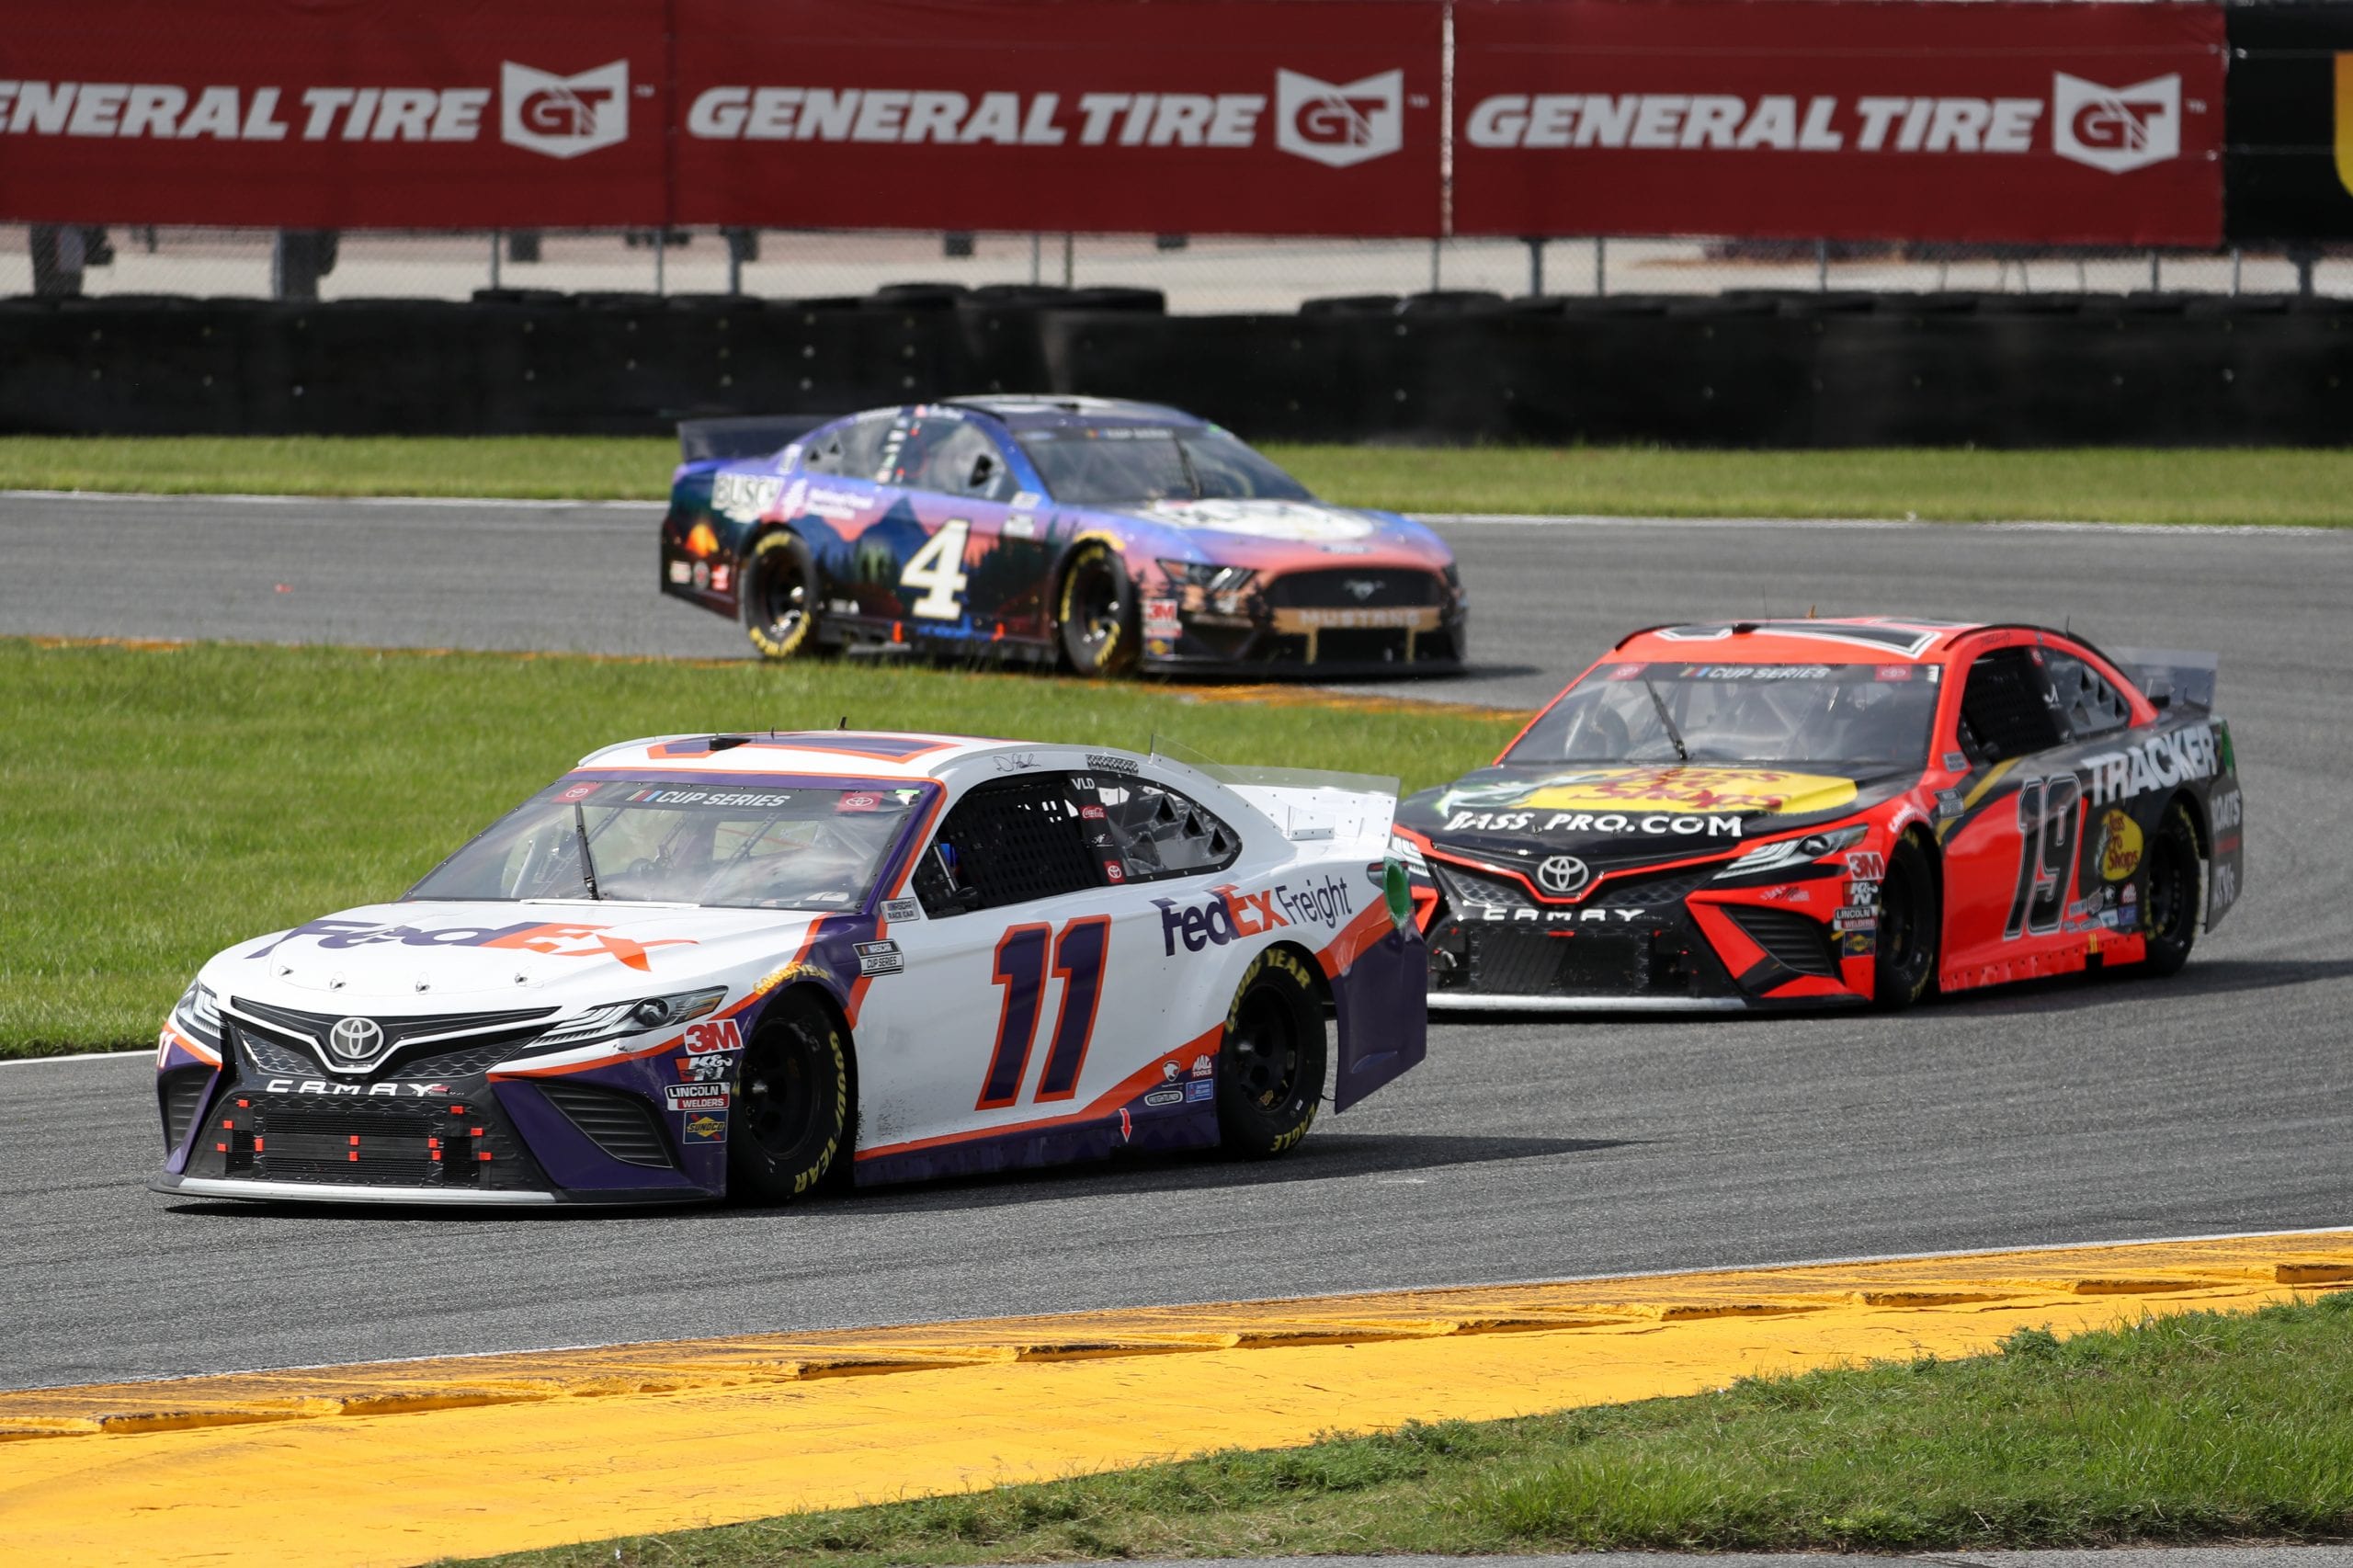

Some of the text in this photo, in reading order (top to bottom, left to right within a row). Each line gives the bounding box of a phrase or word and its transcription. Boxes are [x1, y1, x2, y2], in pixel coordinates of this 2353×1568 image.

[0, 79, 491, 141] NERAL TIRE
[688, 86, 1267, 147] GENERAL TIRE
[1466, 94, 2043, 153] GENERAL TIRE
[900, 517, 972, 620] 4
[1148, 603, 1175, 620] 3M
[1300, 610, 1421, 627] MUSTANG
[1709, 666, 1832, 679] CUP SERIES
[2081, 724, 2218, 807] TRACKER
[1071, 778, 1096, 790] VLD
[654, 790, 790, 807] CUP SERIES
[1443, 811, 1536, 833] BASS
[2003, 773, 2083, 940] 19
[1849, 854, 1885, 880] 3M
[889, 911, 902, 919] RACE
[1149, 873, 1353, 958] FedEx Freight
[1482, 907, 1646, 923] CAMRY
[1836, 908, 1870, 919] LINCOLN
[1845, 919, 1876, 928] WELDERS
[244, 919, 699, 972] FedEx
[867, 956, 897, 969] CUP SERIES
[973, 914, 1112, 1110] 11
[686, 1020, 741, 1054] 3M
[1192, 1068, 1212, 1078] TOOLS
[266, 1079, 443, 1097] CAMRY
[669, 1085, 719, 1097] LINCOLN
[682, 1097, 724, 1108] WELDERS
[688, 1121, 725, 1132] SUNOCO
